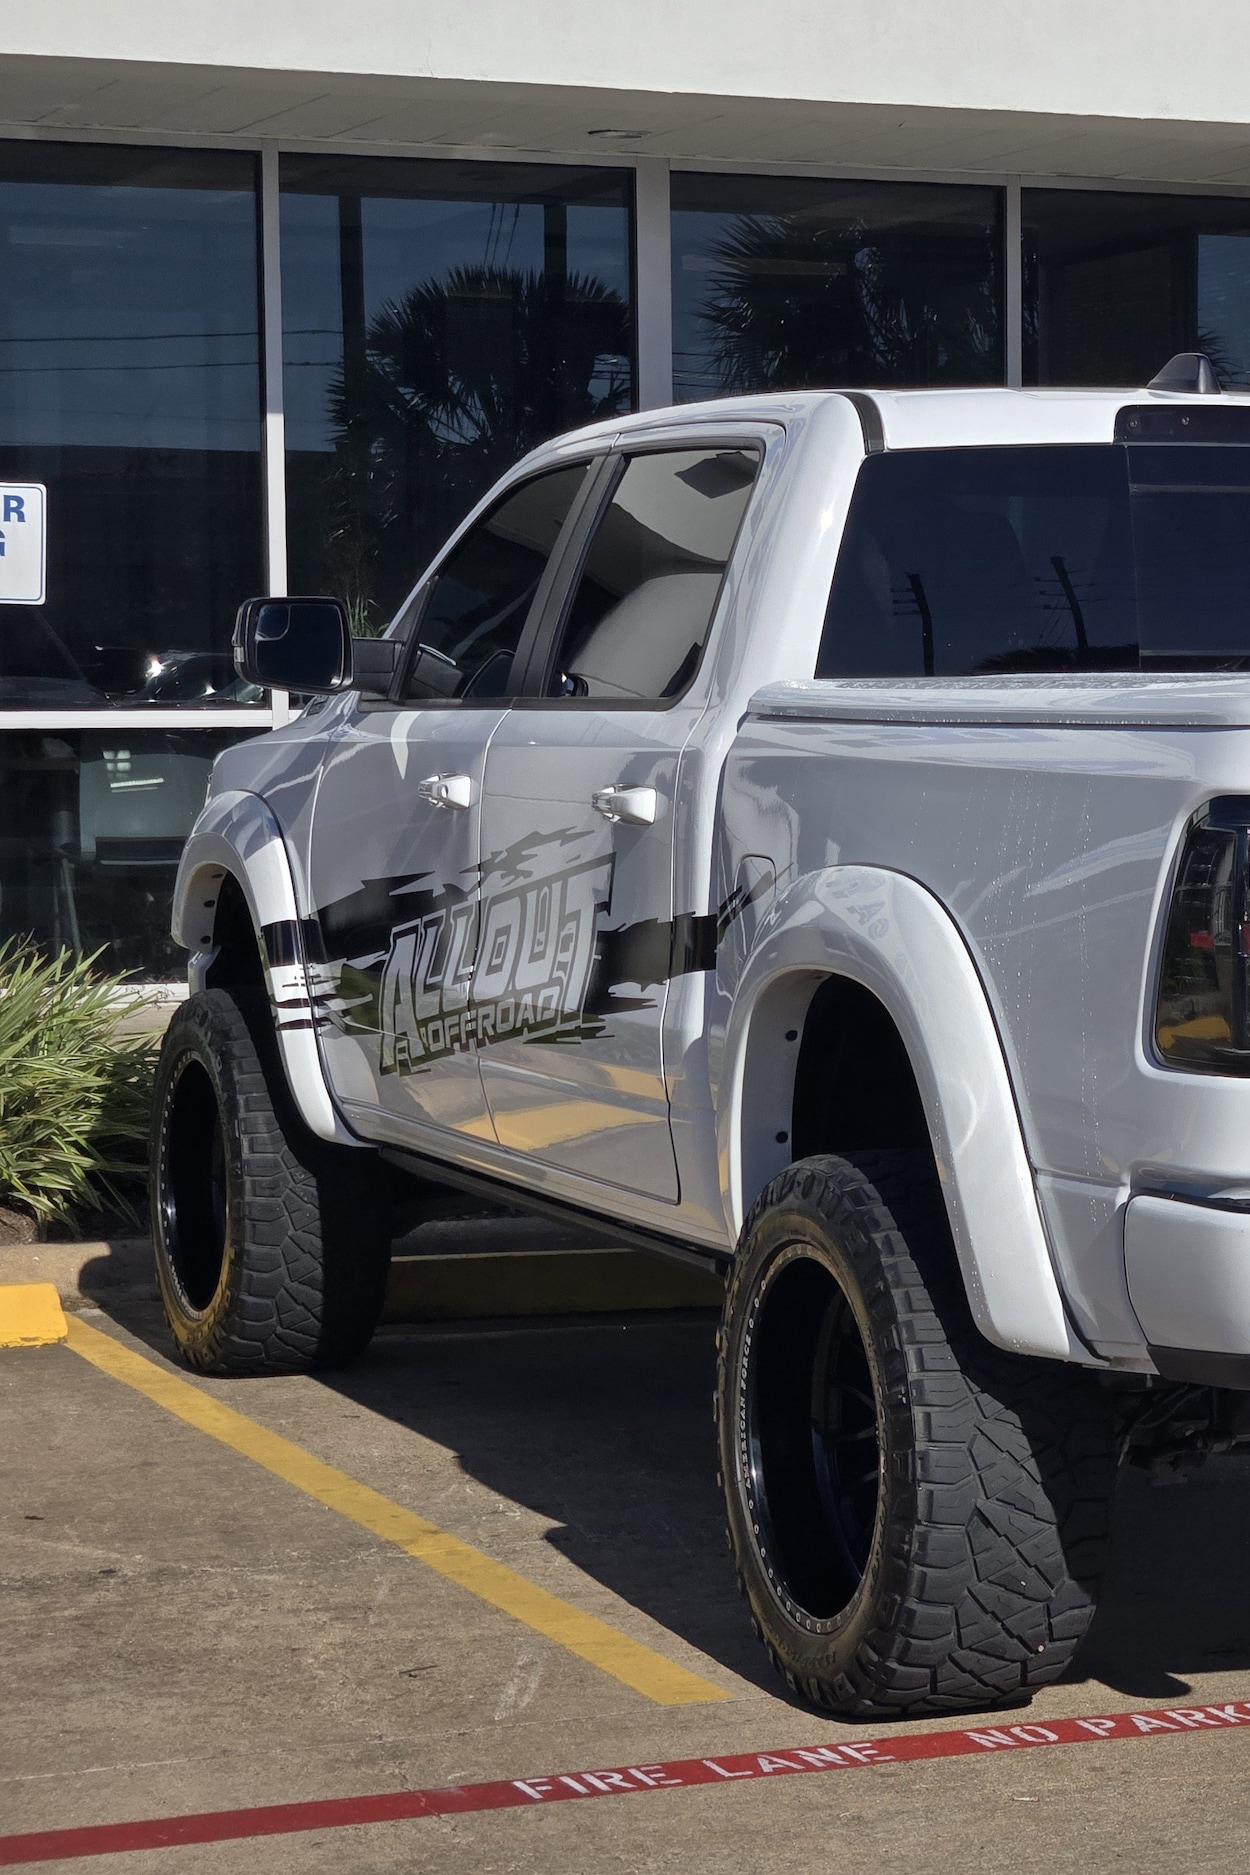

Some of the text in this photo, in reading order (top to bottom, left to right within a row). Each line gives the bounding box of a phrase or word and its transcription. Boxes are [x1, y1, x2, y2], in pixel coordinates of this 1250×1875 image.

[740, 1334, 752, 1489] AMERICAN FORCE
[513, 1765, 682, 1799] FIRE
[702, 1742, 895, 1778] LANE
[964, 1725, 1058, 1749] NO
